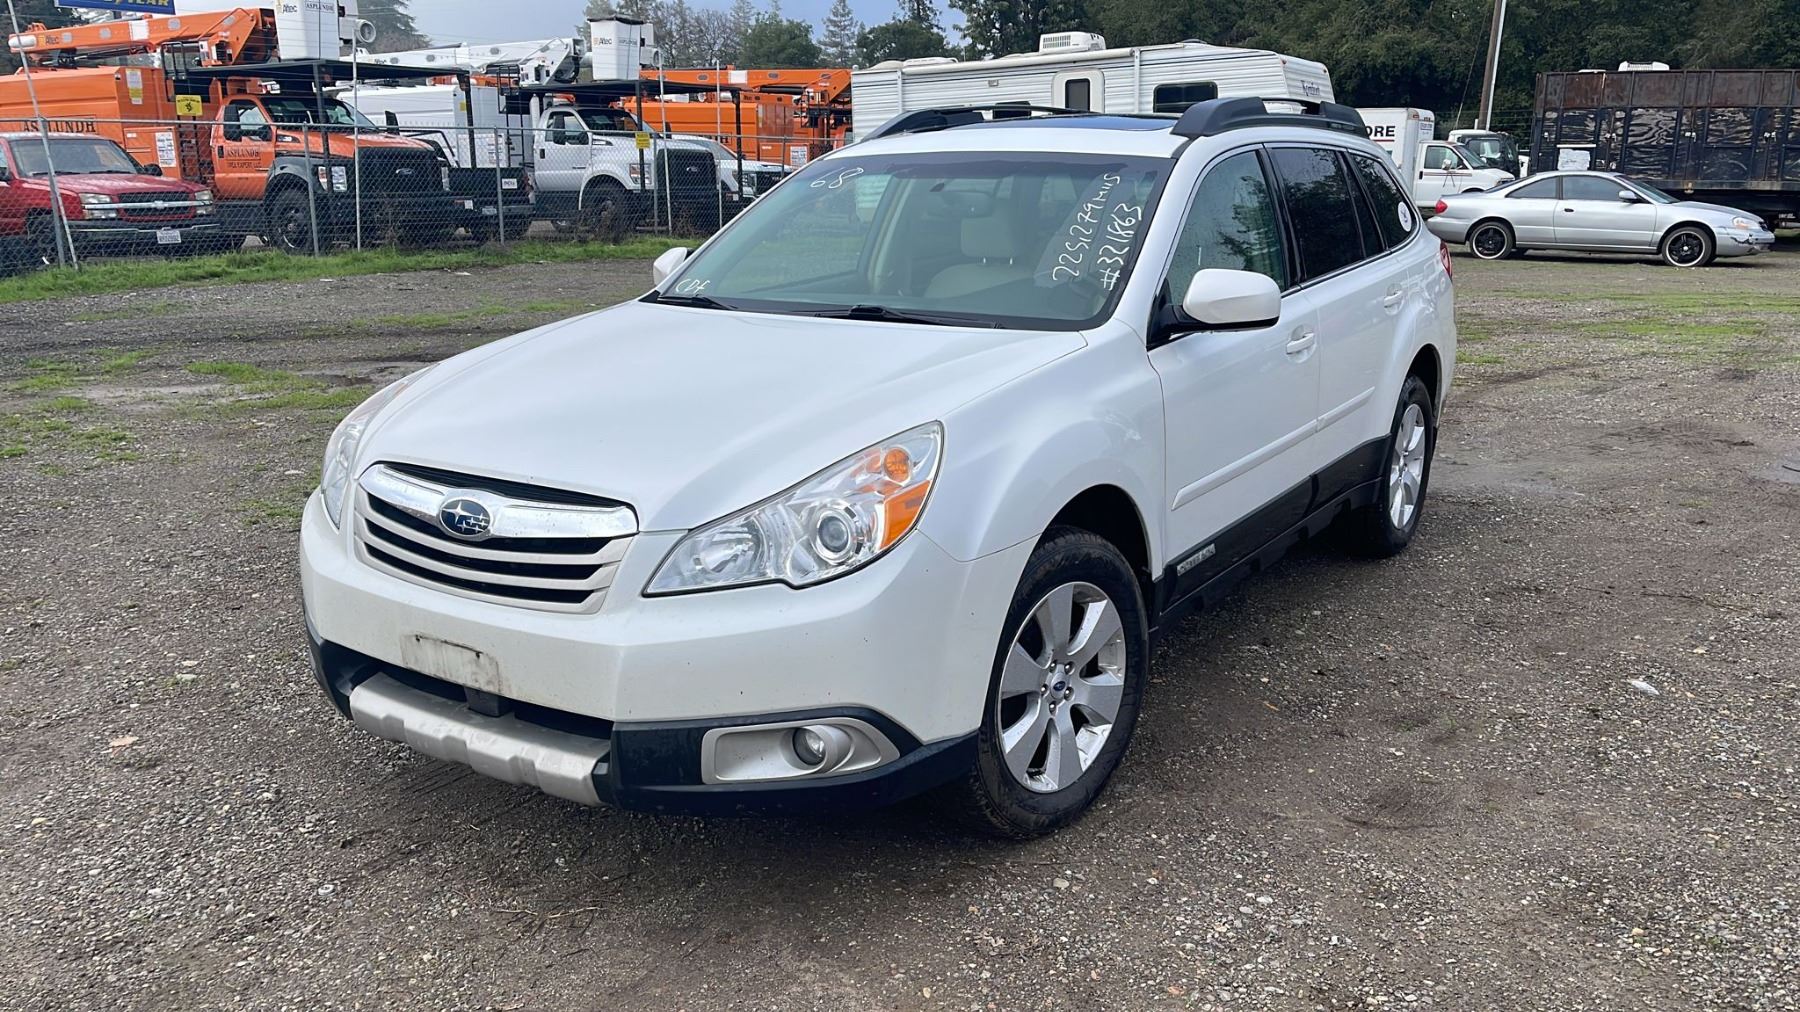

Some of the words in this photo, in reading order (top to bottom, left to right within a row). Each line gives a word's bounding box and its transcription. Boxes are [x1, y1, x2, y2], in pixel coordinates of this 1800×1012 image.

[23, 120, 96, 133] ASLUNDH
[810, 166, 864, 189] 68
[1097, 203, 1141, 291] #321863
